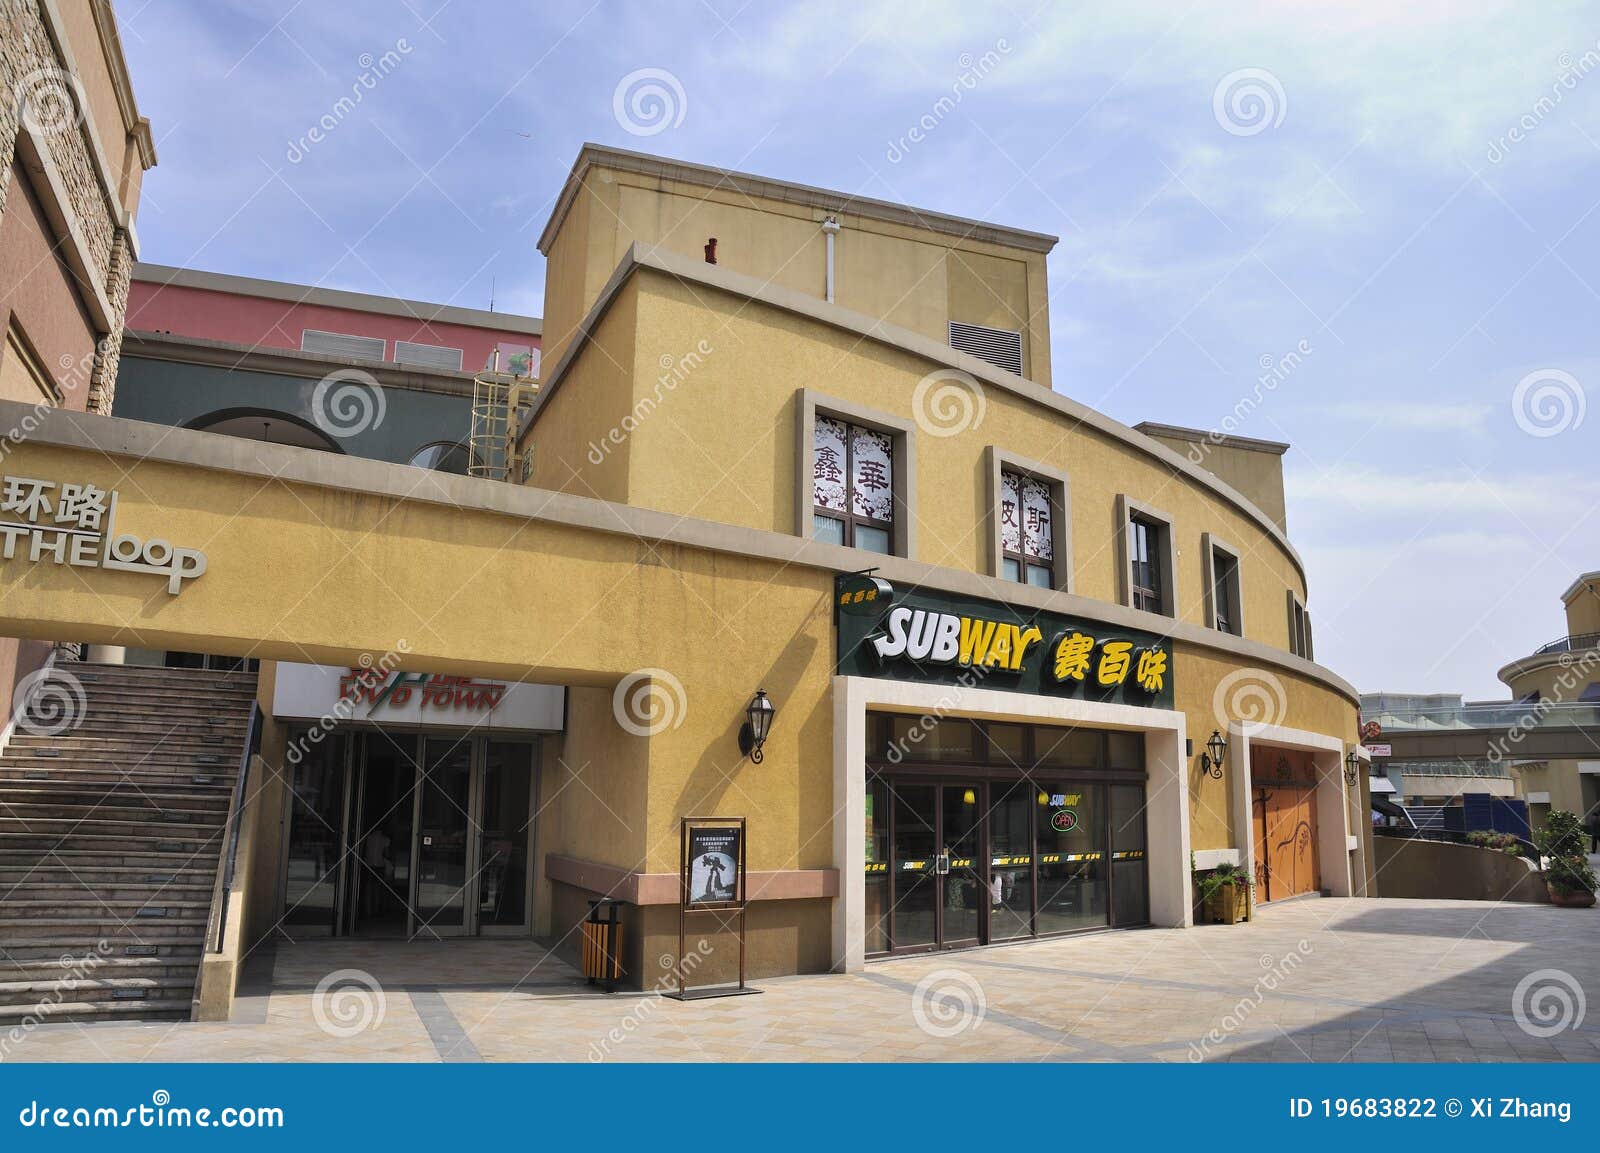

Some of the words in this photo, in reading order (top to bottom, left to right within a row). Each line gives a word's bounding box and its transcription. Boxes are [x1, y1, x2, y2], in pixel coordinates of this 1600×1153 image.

[1, 476, 107, 530] 环路
[0, 526, 101, 568] THE
[874, 607, 1043, 670] SUBWAY
[1055, 632, 1167, 694] 赛百味
[420, 686, 506, 712] TOWN
[1050, 794, 1081, 807] SUBWAY
[1055, 814, 1074, 827] OPEN
